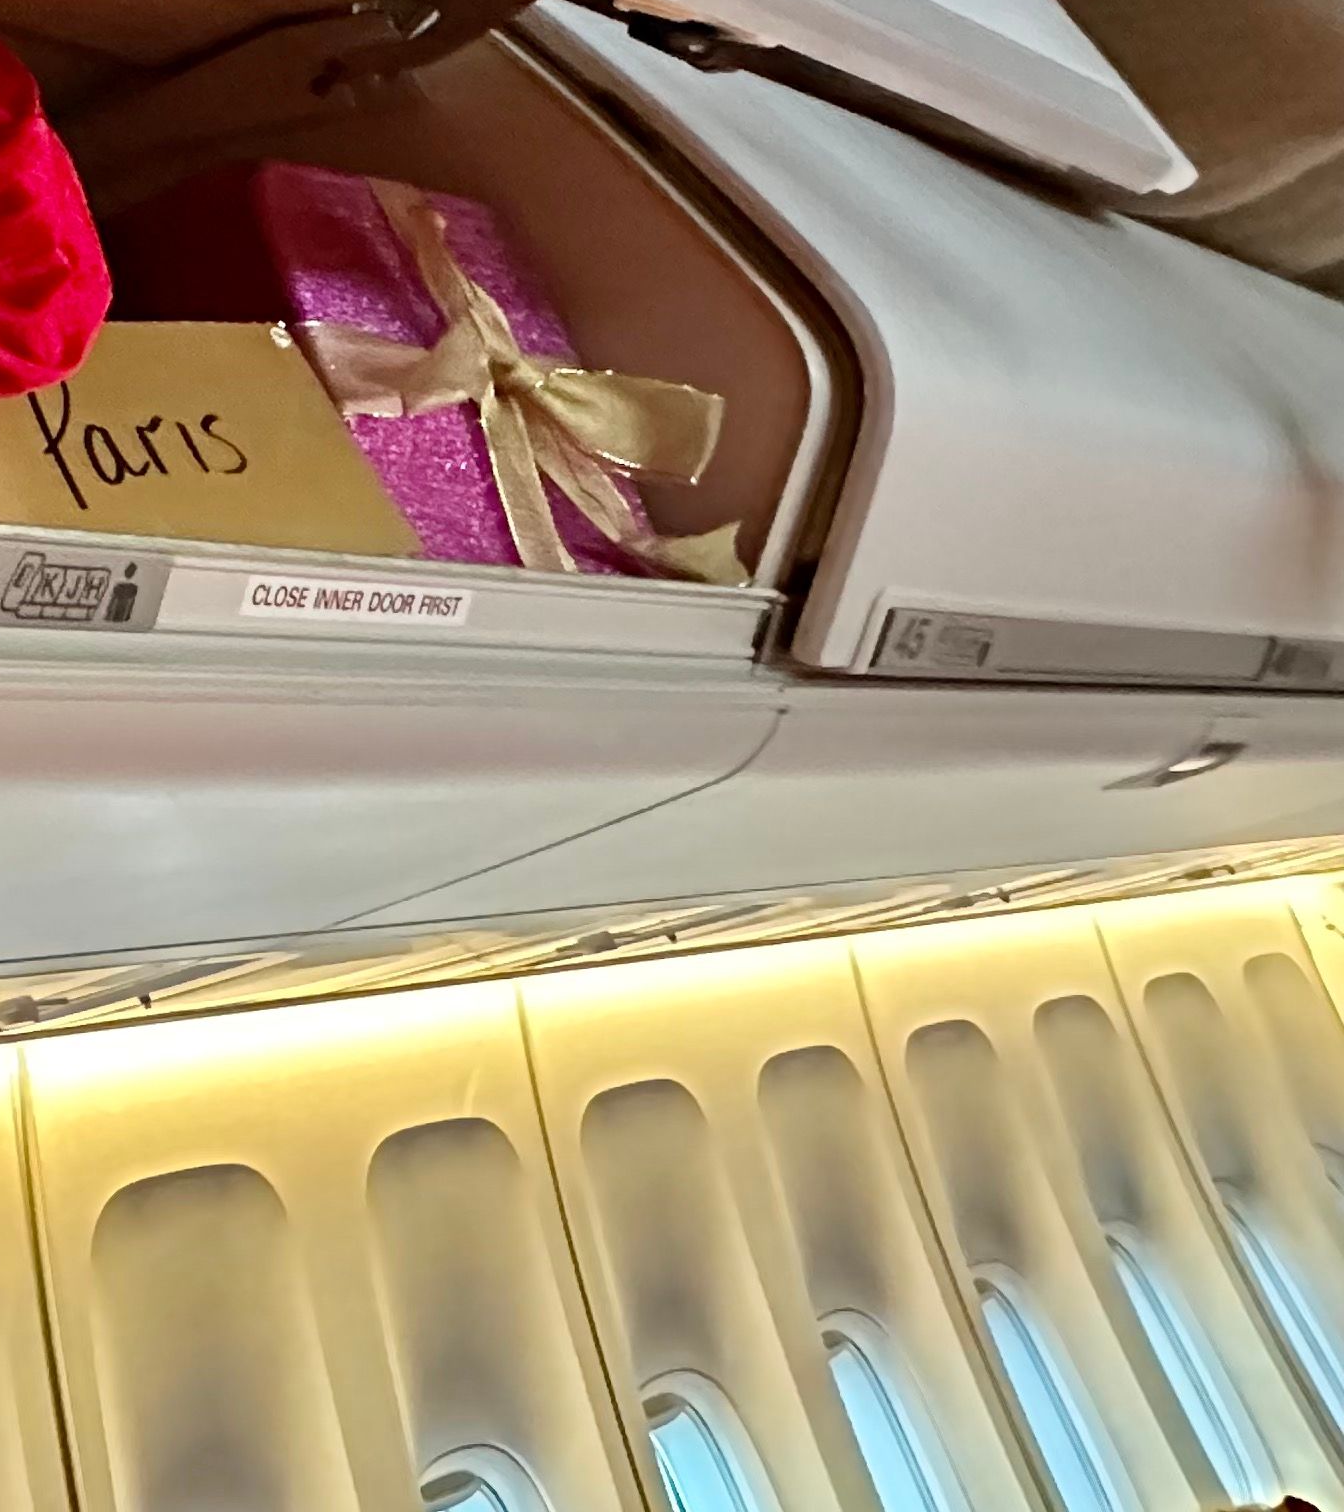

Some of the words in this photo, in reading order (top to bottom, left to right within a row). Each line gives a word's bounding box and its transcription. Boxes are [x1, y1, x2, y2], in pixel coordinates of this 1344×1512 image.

[26, 380, 249, 511] Paris
[252, 584, 310, 608] CLOSE
[313, 587, 364, 612] INNER
[367, 591, 415, 615] DOOR
[418, 594, 463, 617] FIRST
